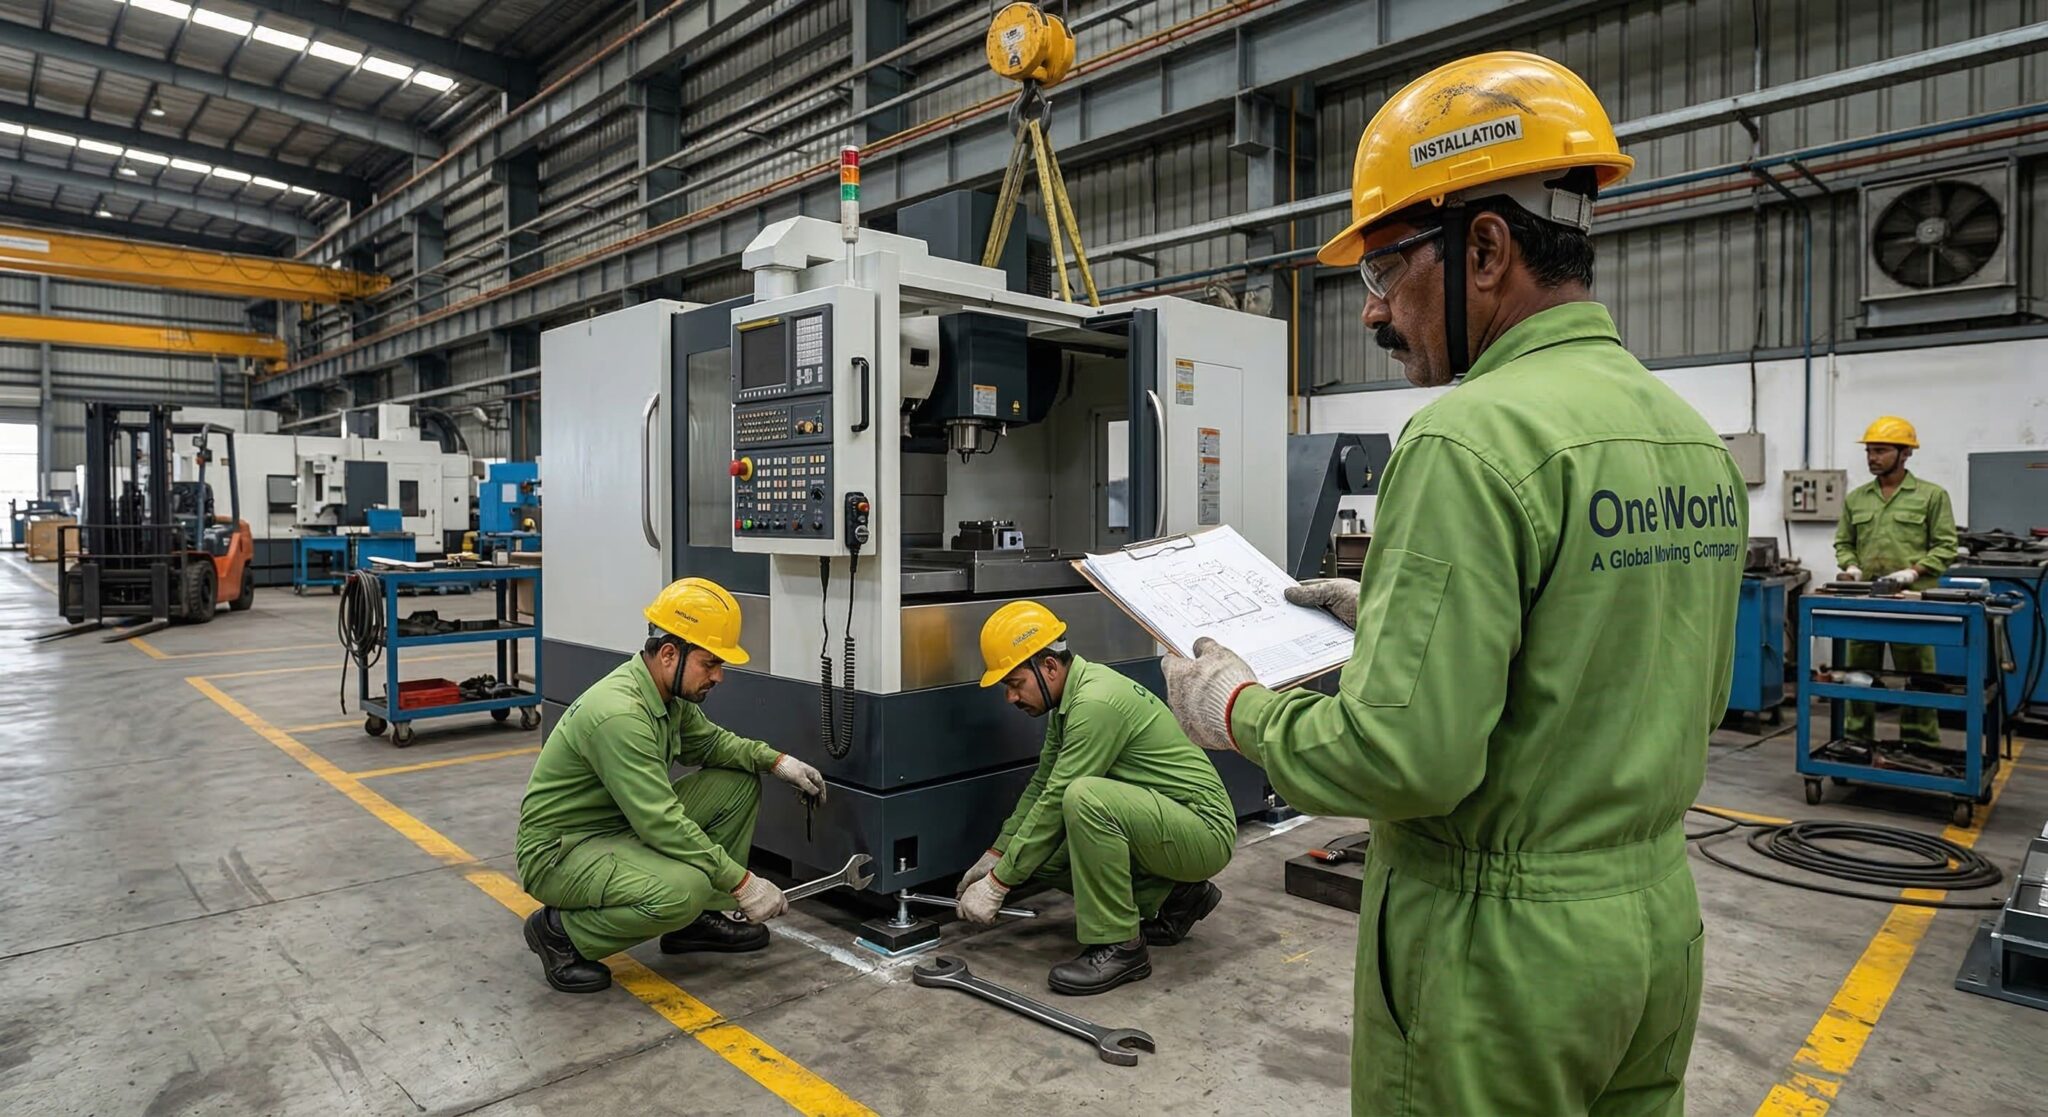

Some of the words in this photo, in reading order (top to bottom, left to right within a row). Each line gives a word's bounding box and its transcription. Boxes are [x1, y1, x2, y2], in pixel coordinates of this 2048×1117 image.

[1413, 119, 1517, 163] INSTALLATION
[1589, 489, 1658, 538] One
[1658, 484, 1738, 530] World
[1590, 552, 1605, 571] A
[1610, 546, 1653, 569] Global
[1694, 540, 1739, 561] Company
